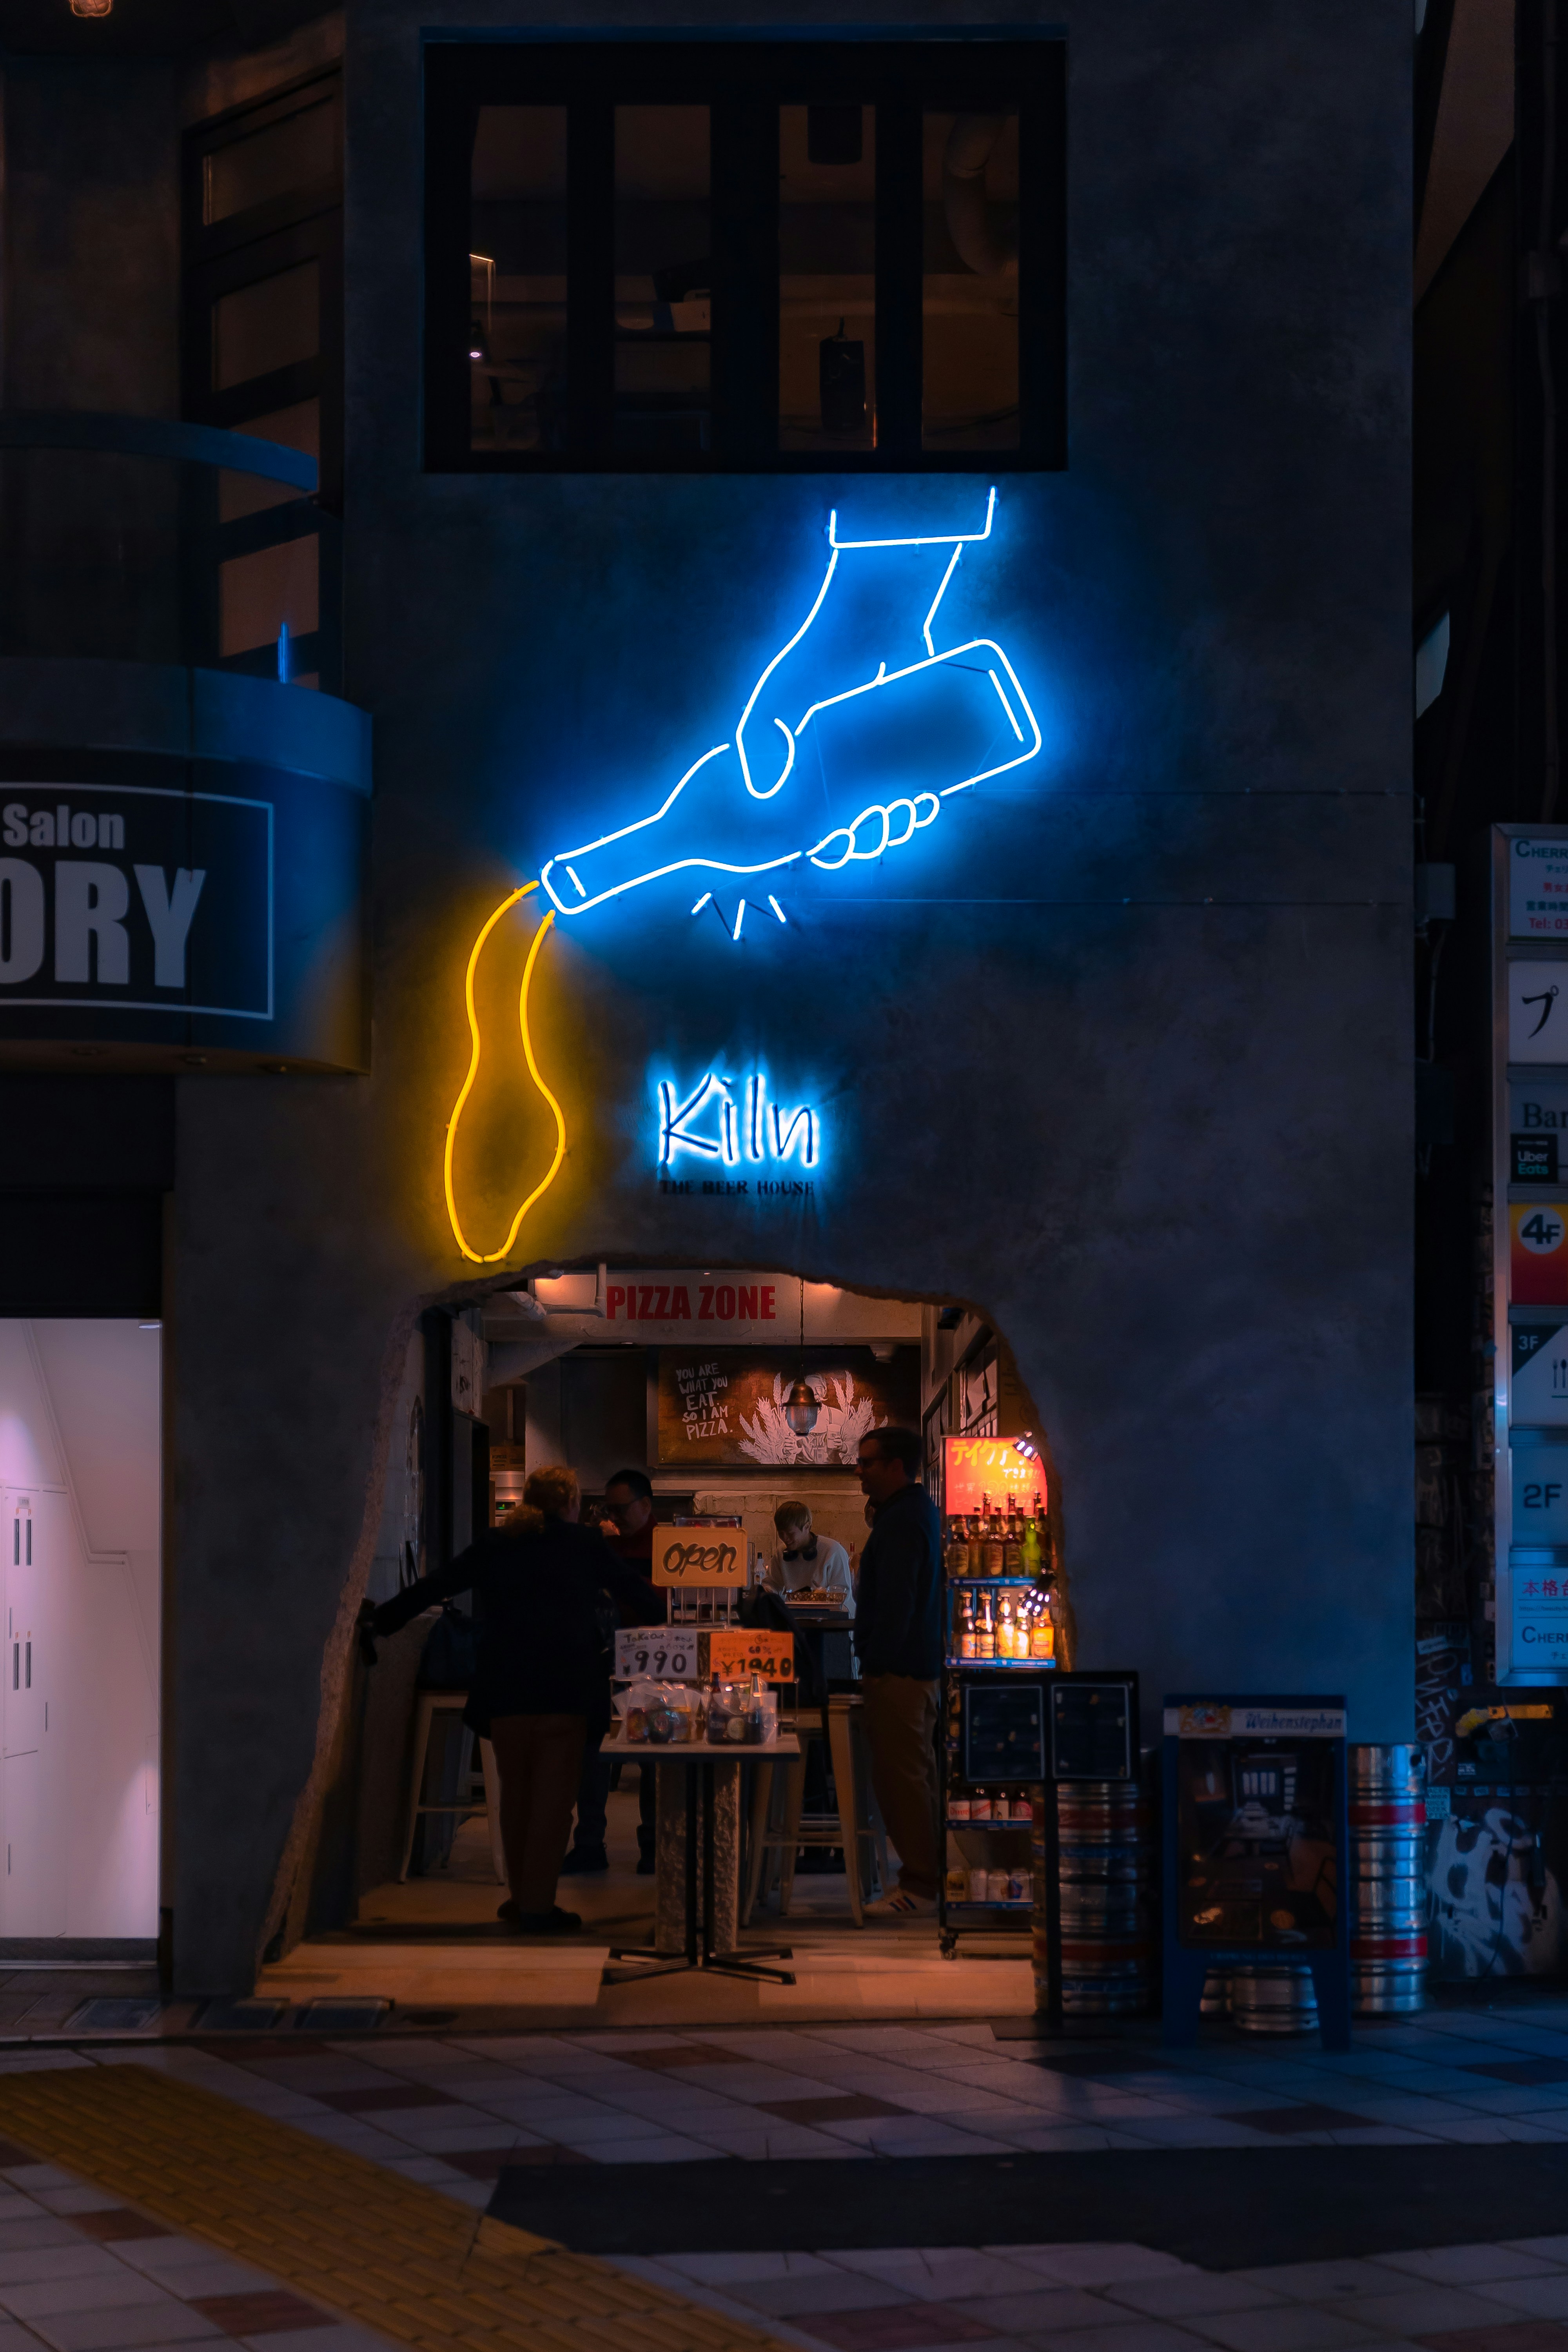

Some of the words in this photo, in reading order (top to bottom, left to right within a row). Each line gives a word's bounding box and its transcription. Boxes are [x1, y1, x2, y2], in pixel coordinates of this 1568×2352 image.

[2, 803, 125, 849] Salon
[1528, 917, 1551, 929] Tel:
[1522, 985, 1559, 1039] プ
[659, 1072, 816, 1165] Kiln
[1517, 1151, 1549, 1162] Uber
[1517, 1163, 1549, 1175] Eats
[659, 1180, 694, 1195] THE
[702, 1180, 748, 1195] BEER
[757, 1180, 815, 1195] HOUSE
[1522, 1214, 1560, 1245] 4F
[606, 1286, 691, 1320] PIZZA
[698, 1285, 776, 1320] ZONE
[1518, 1335, 1539, 1350] 3F
[676, 1367, 695, 1382] YOU
[699, 1363, 720, 1376] ARE
[679, 1378, 708, 1394] WHAT
[711, 1376, 728, 1390] YOU
[686, 1392, 719, 1411] EAT.
[682, 1412, 697, 1423] SO
[702, 1409, 706, 1420] I
[711, 1406, 728, 1419] AM
[686, 1418, 733, 1440] PIZZA.
[1523, 1484, 1562, 1509] 2F
[1521, 1626, 1568, 1643] CHER
[1246, 1711, 1343, 1733] Weihenstephan
